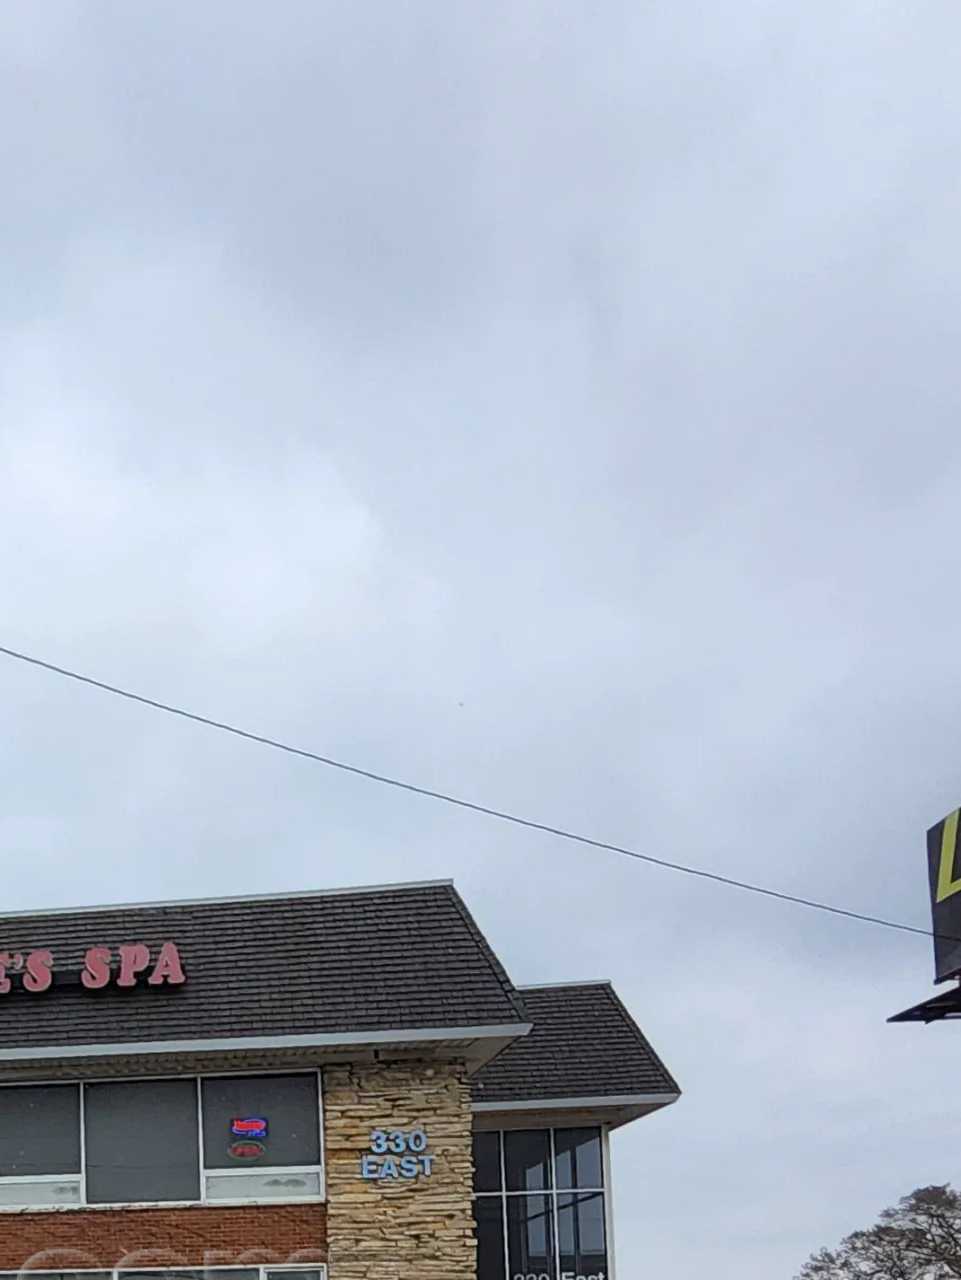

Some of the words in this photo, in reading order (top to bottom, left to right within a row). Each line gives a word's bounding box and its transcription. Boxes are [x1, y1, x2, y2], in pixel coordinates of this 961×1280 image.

[80, 941, 186, 988] SPA
[369, 1128, 427, 1153] 330
[361, 1154, 437, 1180] EAST
